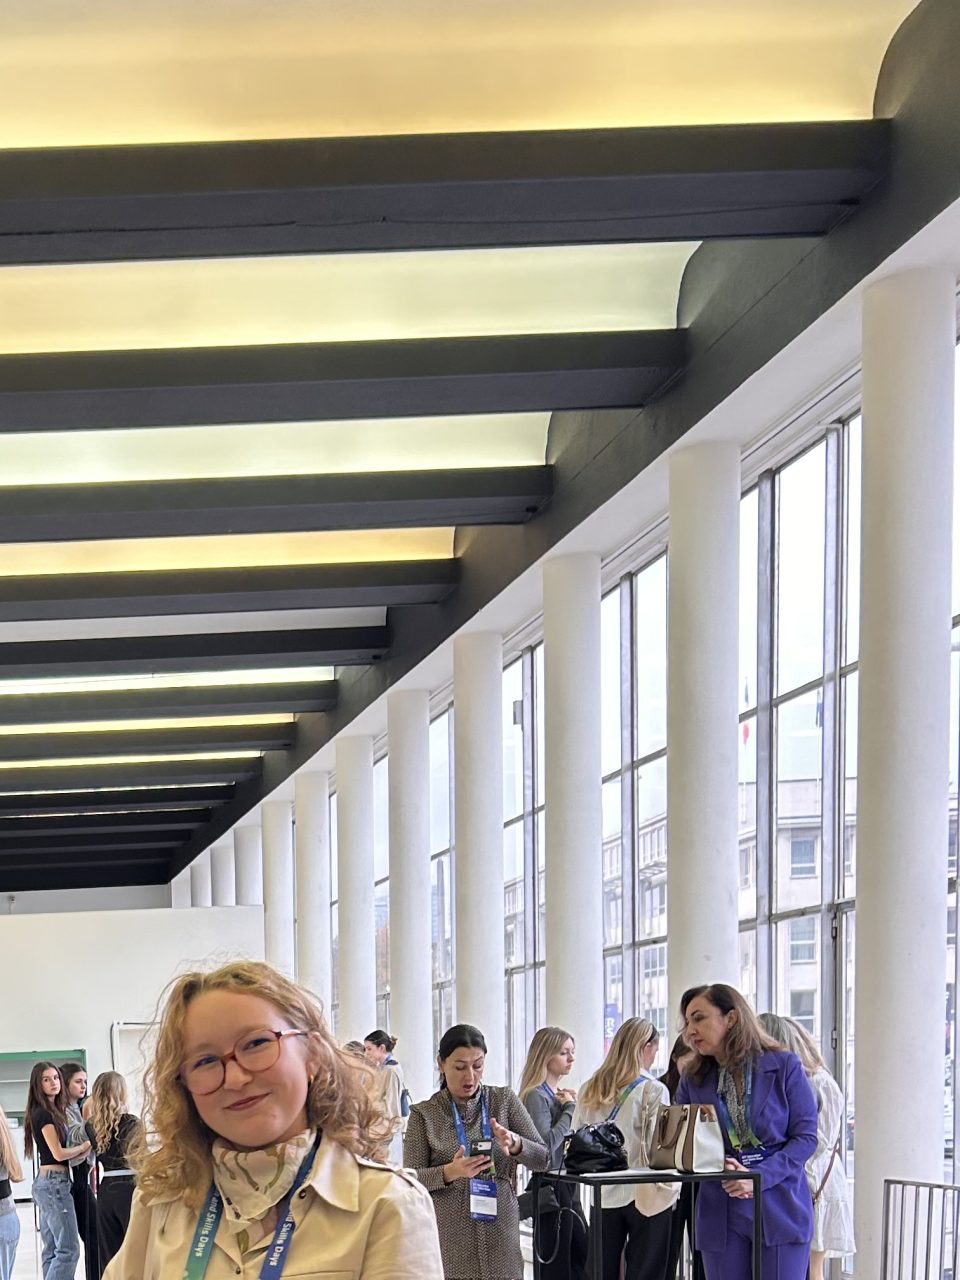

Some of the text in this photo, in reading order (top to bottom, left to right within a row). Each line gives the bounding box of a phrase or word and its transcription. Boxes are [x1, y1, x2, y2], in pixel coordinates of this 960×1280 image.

[209, 1196, 219, 1214] and
[201, 1211, 217, 1235] Skills
[276, 1221, 293, 1244] Skills
[195, 1236, 209, 1257] Days
[269, 1246, 284, 1266] Days
